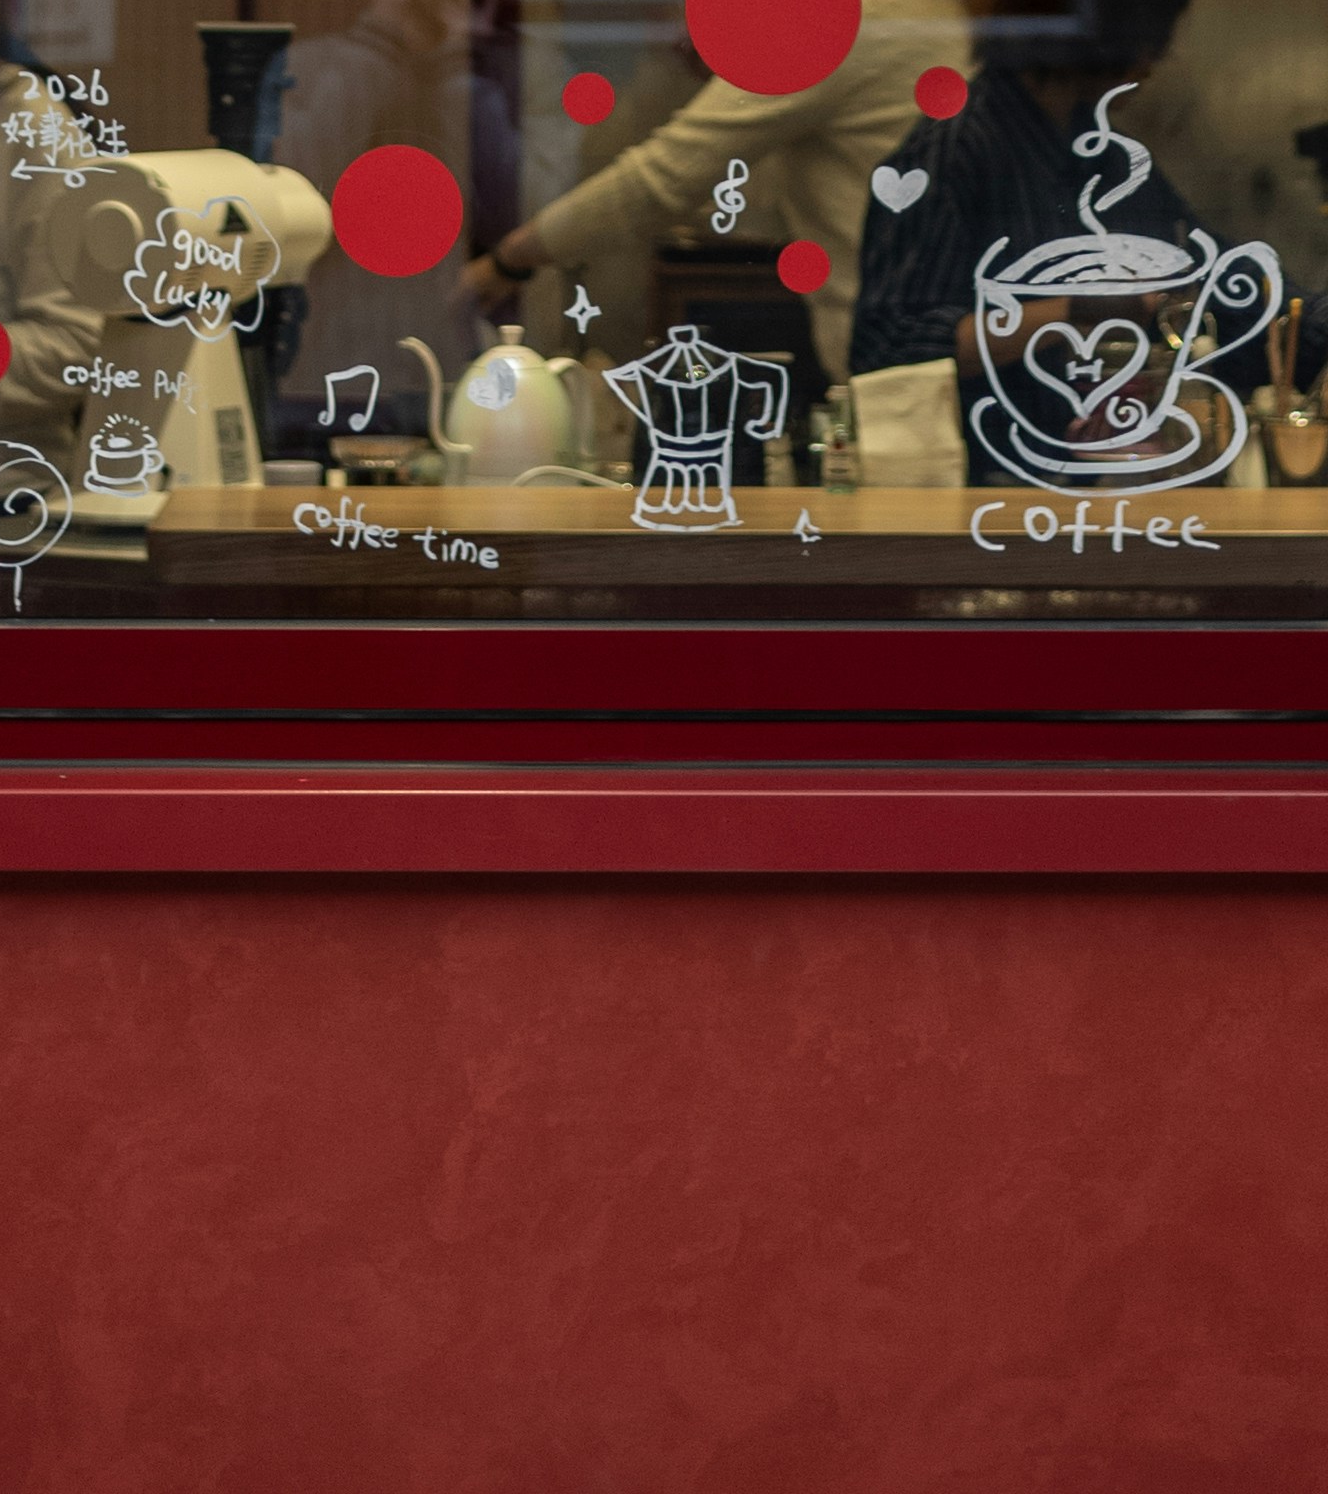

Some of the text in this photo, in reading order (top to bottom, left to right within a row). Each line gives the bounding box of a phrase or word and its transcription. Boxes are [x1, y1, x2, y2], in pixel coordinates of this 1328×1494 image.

[17, 68, 110, 106] 2026
[173, 229, 243, 276] good
[62, 356, 142, 398] coffee
[1065, 358, 1105, 383] H
[412, 526, 500, 569] time
